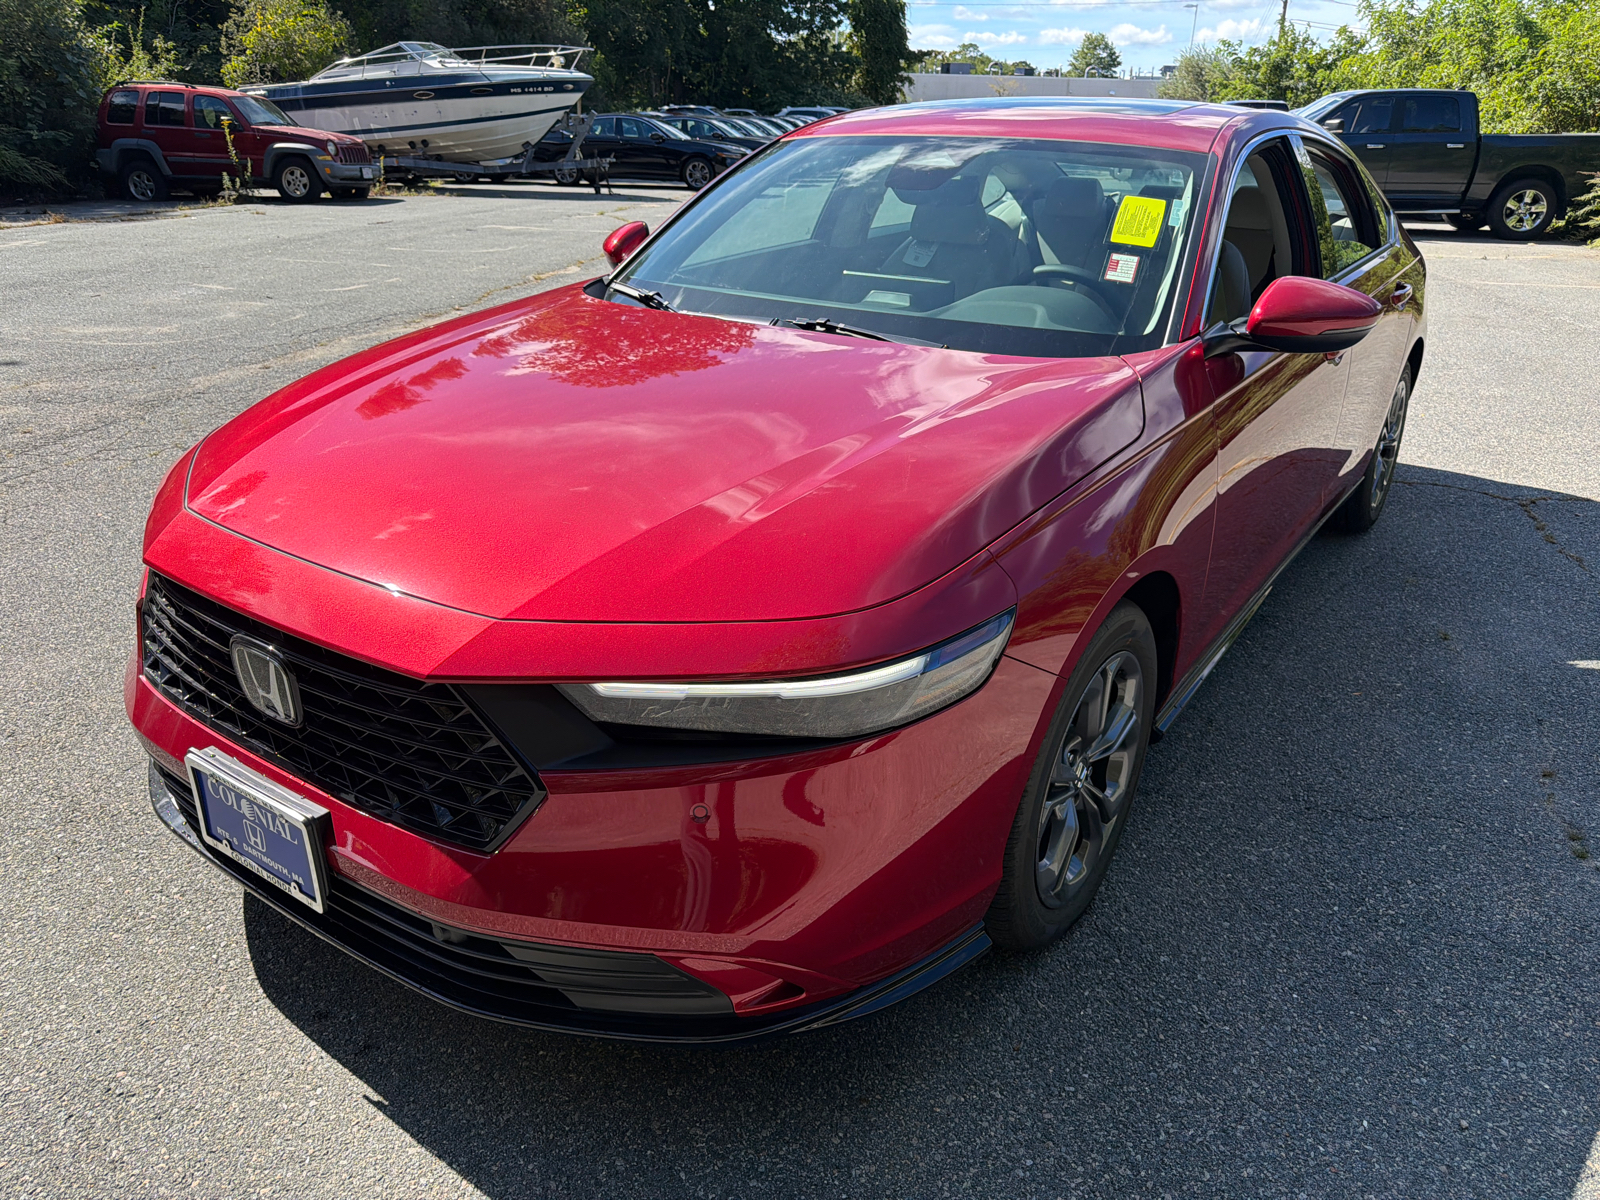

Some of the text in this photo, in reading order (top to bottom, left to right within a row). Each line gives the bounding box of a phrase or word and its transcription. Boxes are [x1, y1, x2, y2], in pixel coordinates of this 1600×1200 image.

[208, 778, 298, 845] COLONIAL
[231, 851, 293, 895] COLONIAL HONDA
[233, 837, 239, 845] 6
[242, 843, 291, 878] DARTMOUTH,
[291, 872, 305, 885] MA
